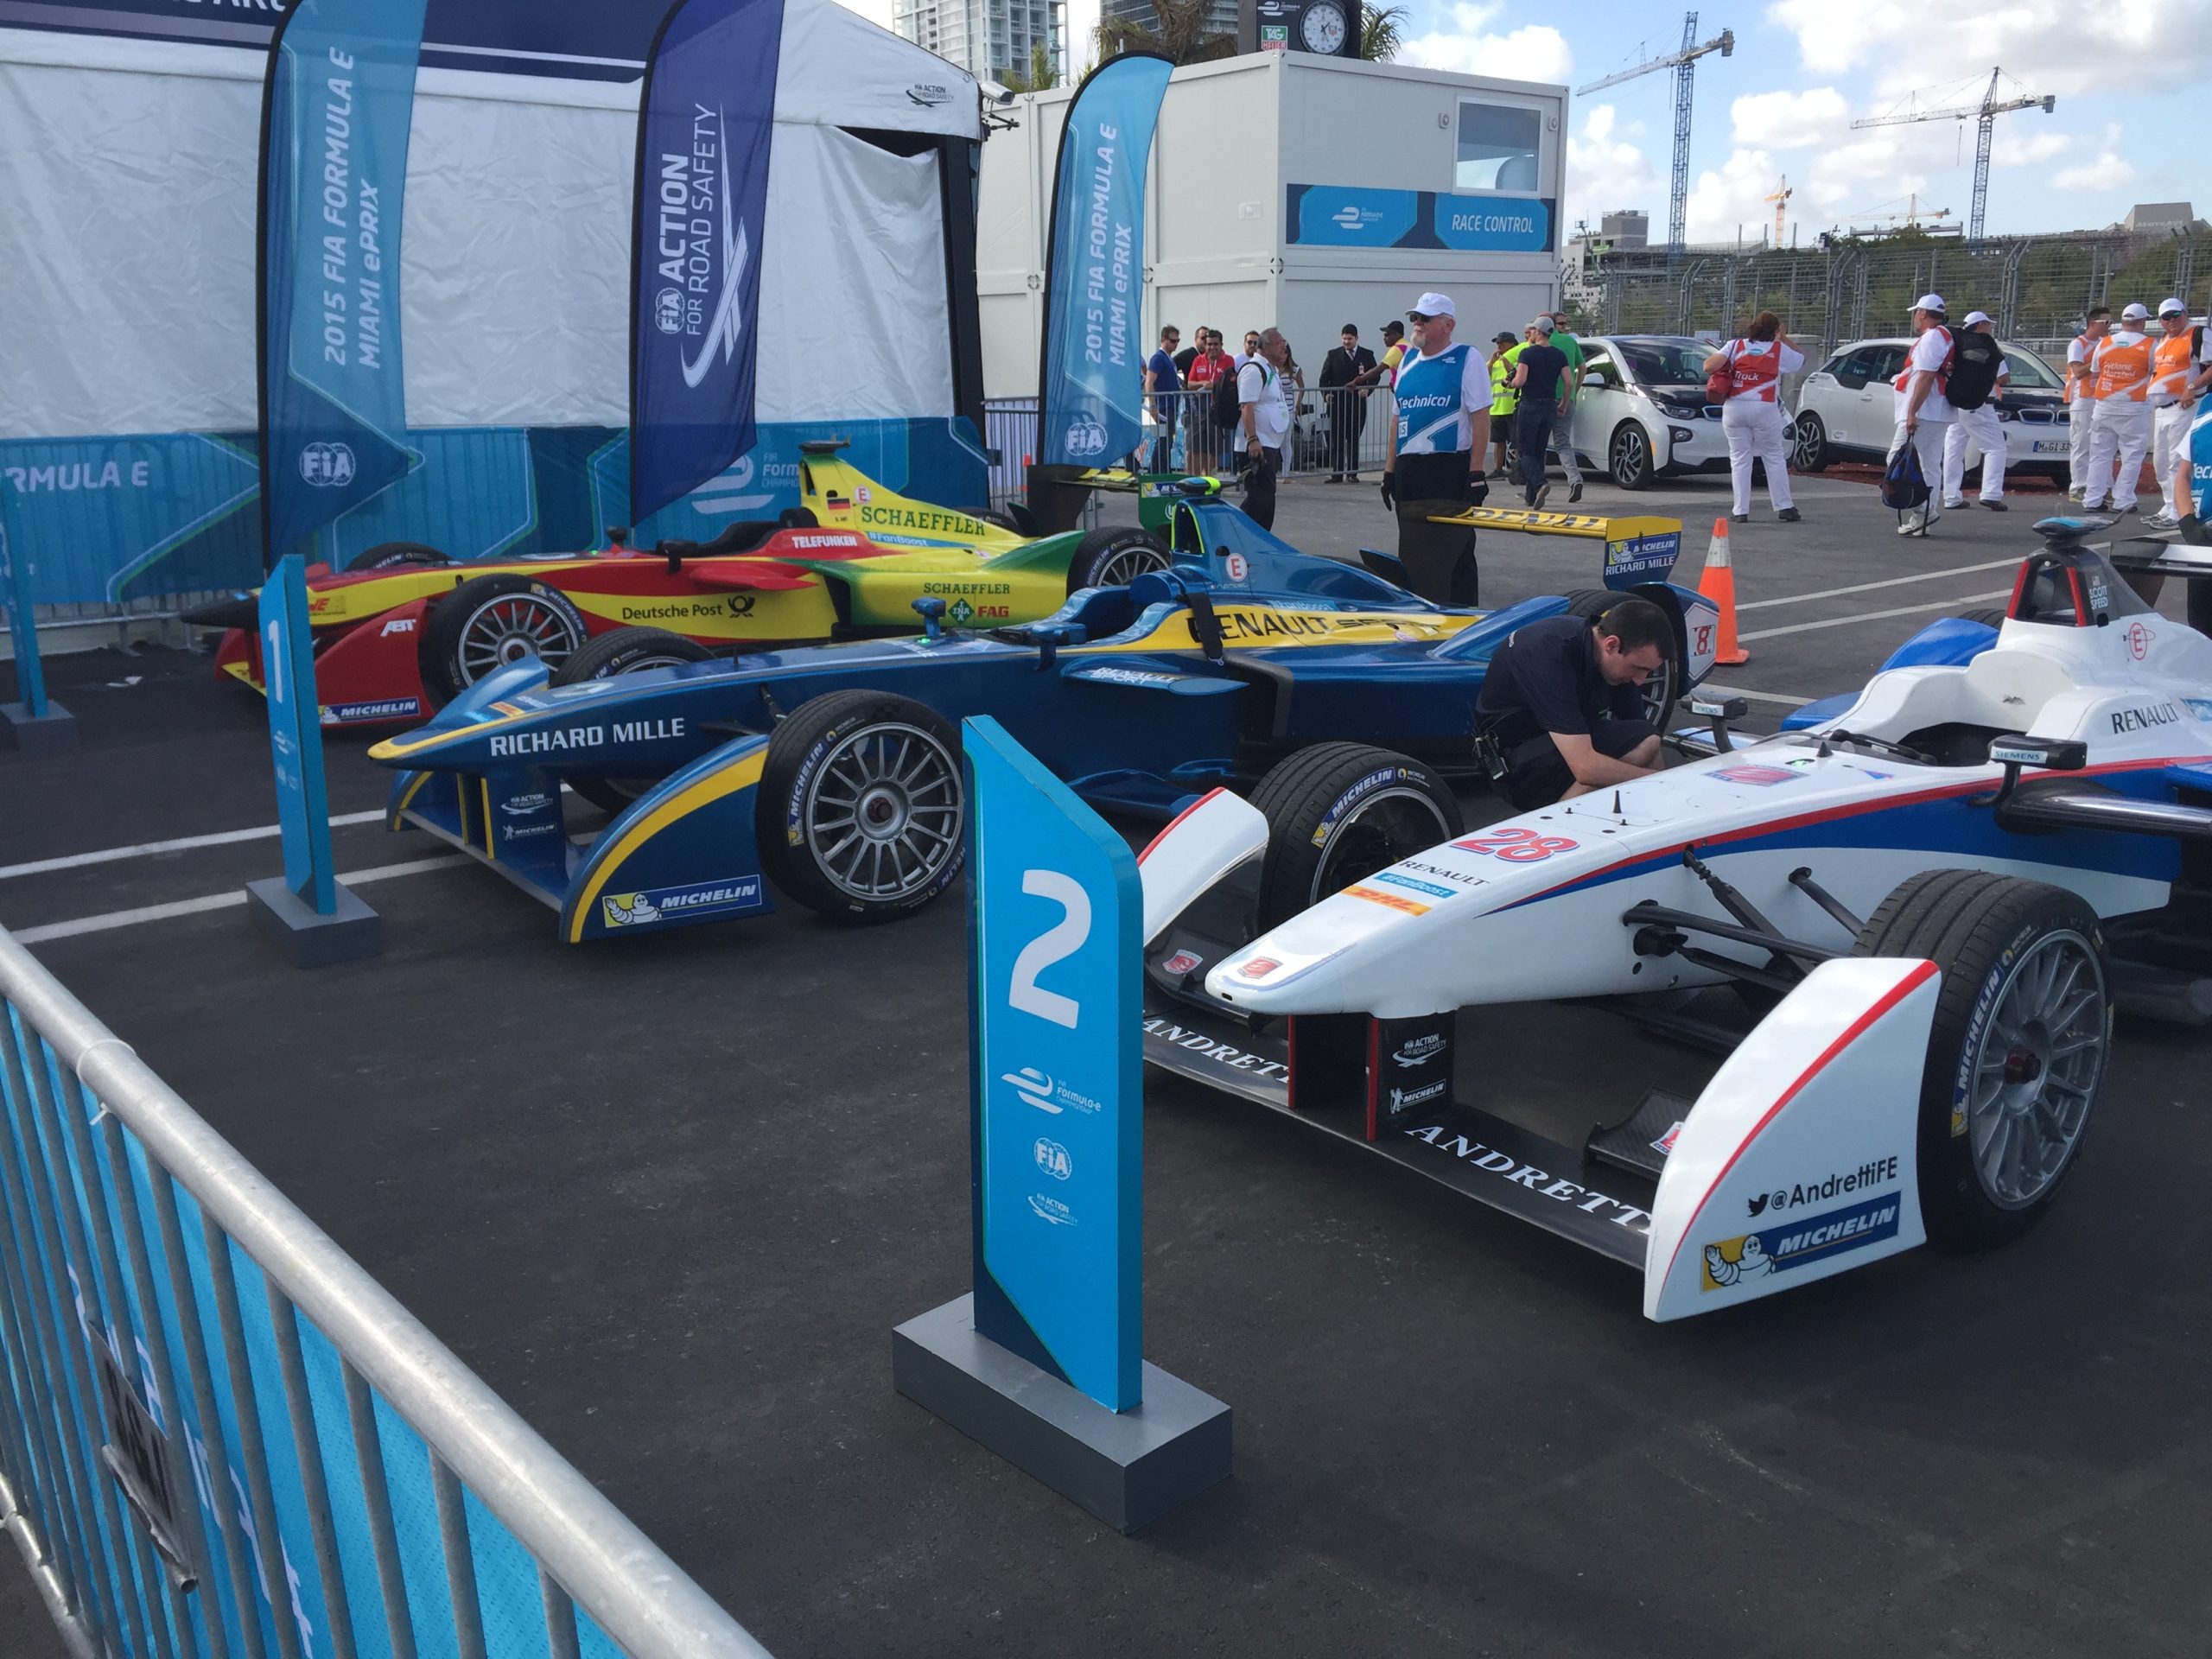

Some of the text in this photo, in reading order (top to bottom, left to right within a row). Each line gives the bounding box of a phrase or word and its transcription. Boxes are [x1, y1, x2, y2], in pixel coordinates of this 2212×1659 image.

[1265, 28, 1284, 41] TAG
[924, 85, 946, 93] ACTION
[323, 47, 353, 366] 2015 FIA FORMULA E
[658, 153, 689, 284] ACTION
[687, 103, 716, 335] FOR ROAD SAFETY
[1452, 214, 1534, 233] RACE CONTROL
[1085, 123, 1117, 365] 2015 FIA FORMULA E
[359, 177, 380, 370] MIAMI ePRIX
[1109, 222, 1132, 366] MIAMI ePRIX
[1734, 371, 1759, 381] Track
[1398, 394, 1451, 410] Technical
[3, 460, 149, 493] RMULA E
[762, 463, 799, 476] Form
[2192, 462, 2212, 479] Tec
[761, 478, 799, 488] CHAMPIO
[861, 505, 986, 537] SCHAEFFLER
[791, 536, 858, 550] TELEFUNKEN
[868, 531, 928, 547] #FanBoost
[1605, 555, 1675, 575] RICHARD MILLE
[924, 582, 1010, 594] SCHAEFFLER
[2088, 585, 2107, 599] SCOTT
[549, 591, 585, 631] MICHELIN
[622, 604, 723, 620] Deutsche Post
[977, 606, 1009, 618] FAG
[2090, 596, 2108, 610] SPEED
[1697, 626, 1709, 655] 8
[268, 620, 283, 704] 1
[341, 700, 416, 716] MICHELIN
[2111, 702, 2179, 734] RENAULT
[490, 717, 685, 757] RICHARD MILLE
[1995, 750, 2040, 760] SIEMENS
[790, 742, 824, 817] MICHELIN
[520, 793, 544, 802] ACTION
[1332, 769, 1393, 819] MICHELIN
[515, 824, 555, 835] MICHELIN
[1449, 827, 1580, 862] 28
[1382, 873, 1450, 896] #FanBoost
[1399, 860, 1491, 887] RENAULT
[661, 884, 756, 909] MICHELIN
[1354, 888, 1414, 909] DHL
[1008, 869, 1092, 1030] 2
[1957, 967, 2000, 1090] MICHELIN
[1143, 1019, 1288, 1084] ANDRET
[1412, 1045, 1427, 1055] ROAD
[1428, 1039, 1447, 1052] SAFETY
[1414, 1033, 1440, 1048] ACTION
[1403, 1082, 1445, 1103] MICHELIN
[1404, 1125, 1654, 1236] ANDRETT
[1770, 1155, 1898, 1211] @AndrettiFE
[1046, 1197, 1070, 1214] ACTION
[1777, 1205, 1897, 1255] MICHELIN
